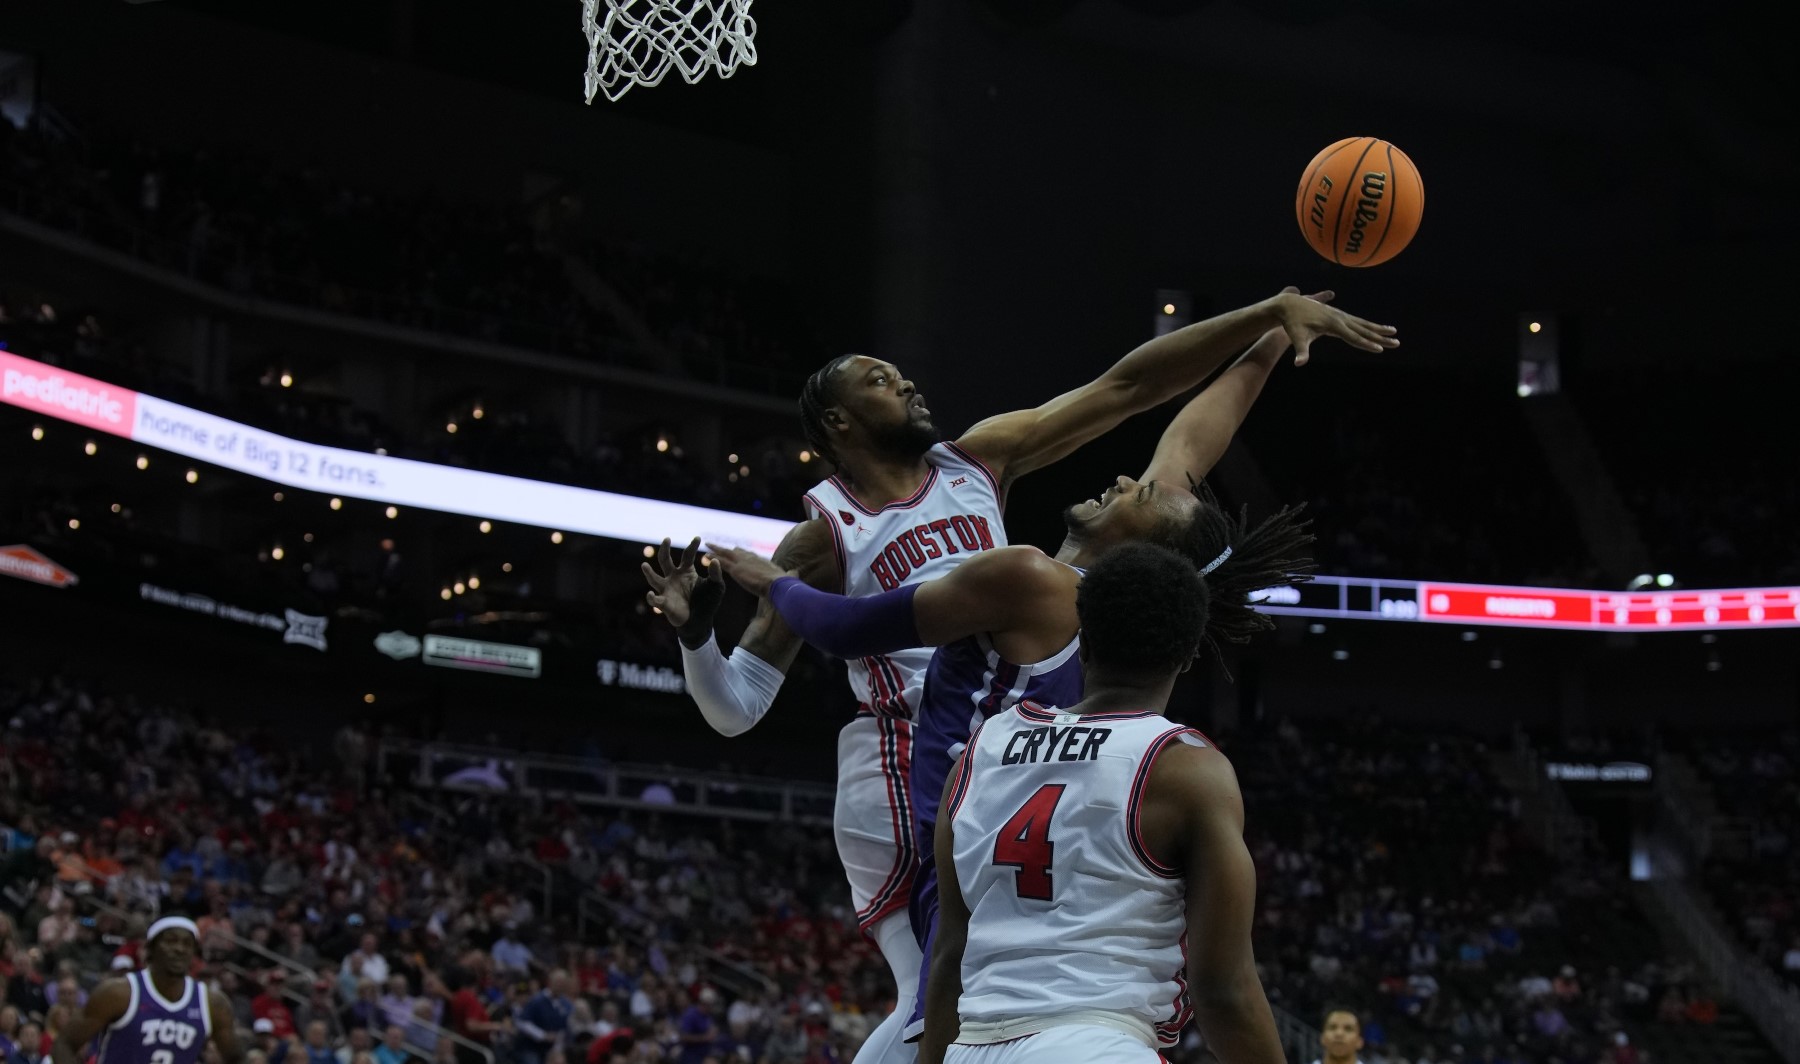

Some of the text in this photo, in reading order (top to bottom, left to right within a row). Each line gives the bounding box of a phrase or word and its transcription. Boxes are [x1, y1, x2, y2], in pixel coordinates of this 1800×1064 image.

[1344, 171, 1386, 254] Wilson
[3, 368, 122, 423] pediatric
[140, 408, 386, 486] home of Big 12 fans.
[870, 514, 995, 593] HOUSTON
[619, 661, 684, 694] Mobile
[1001, 726, 1112, 766] CRYER
[992, 783, 1067, 902] 4
[140, 1018, 197, 1050] TCU
